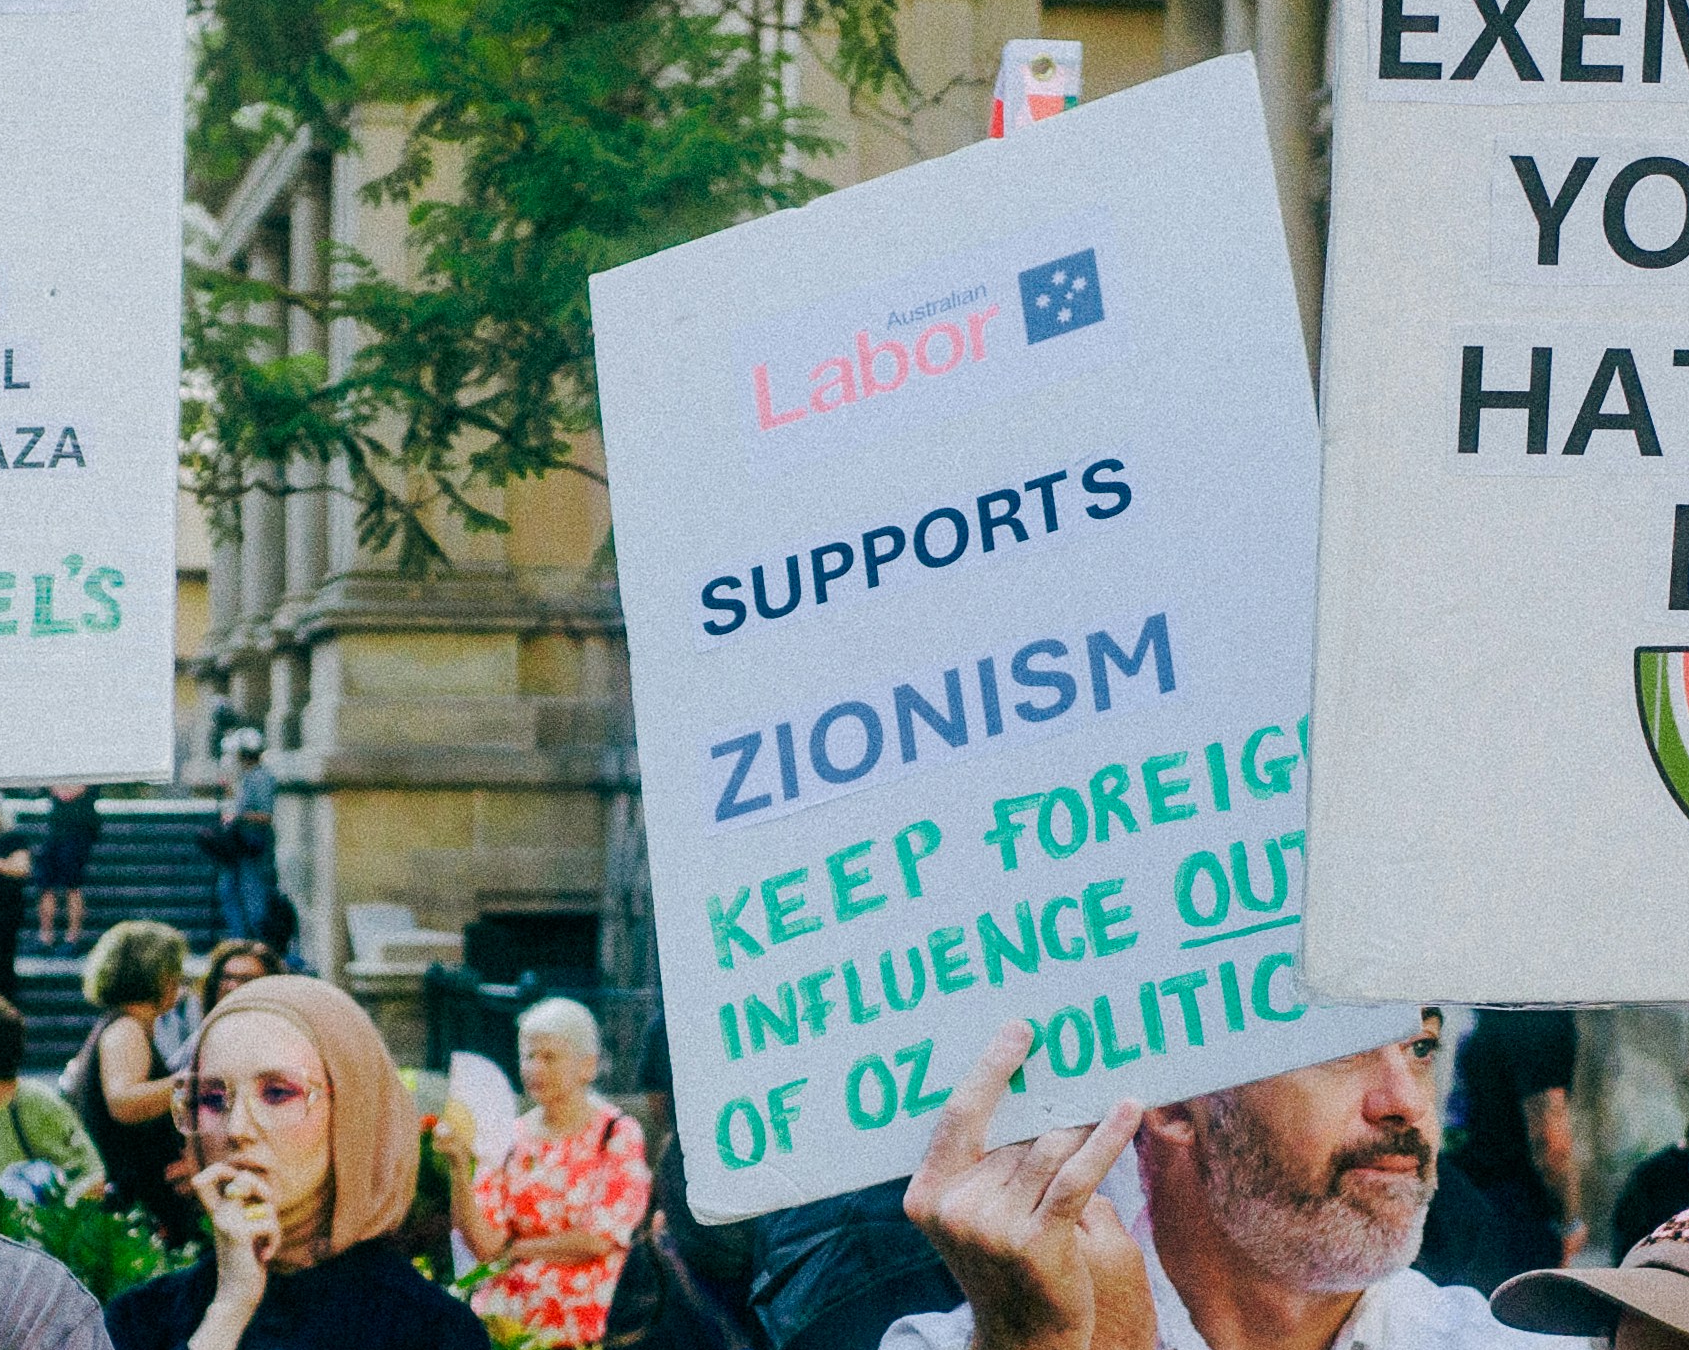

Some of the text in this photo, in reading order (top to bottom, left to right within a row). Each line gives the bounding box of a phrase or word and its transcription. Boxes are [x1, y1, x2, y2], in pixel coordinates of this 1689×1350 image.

[751, 303, 1000, 431] Labor
[885, 282, 988, 330] Australian
[700, 458, 1133, 637] SUPPORTS
[710, 611, 1178, 823] ZIONISM
[706, 715, 1309, 970] KEEP FOREIG
[718, 878, 1138, 1060] INFLUENCE
[714, 1077, 810, 1171] OF
[844, 1040, 953, 1131] OZ
